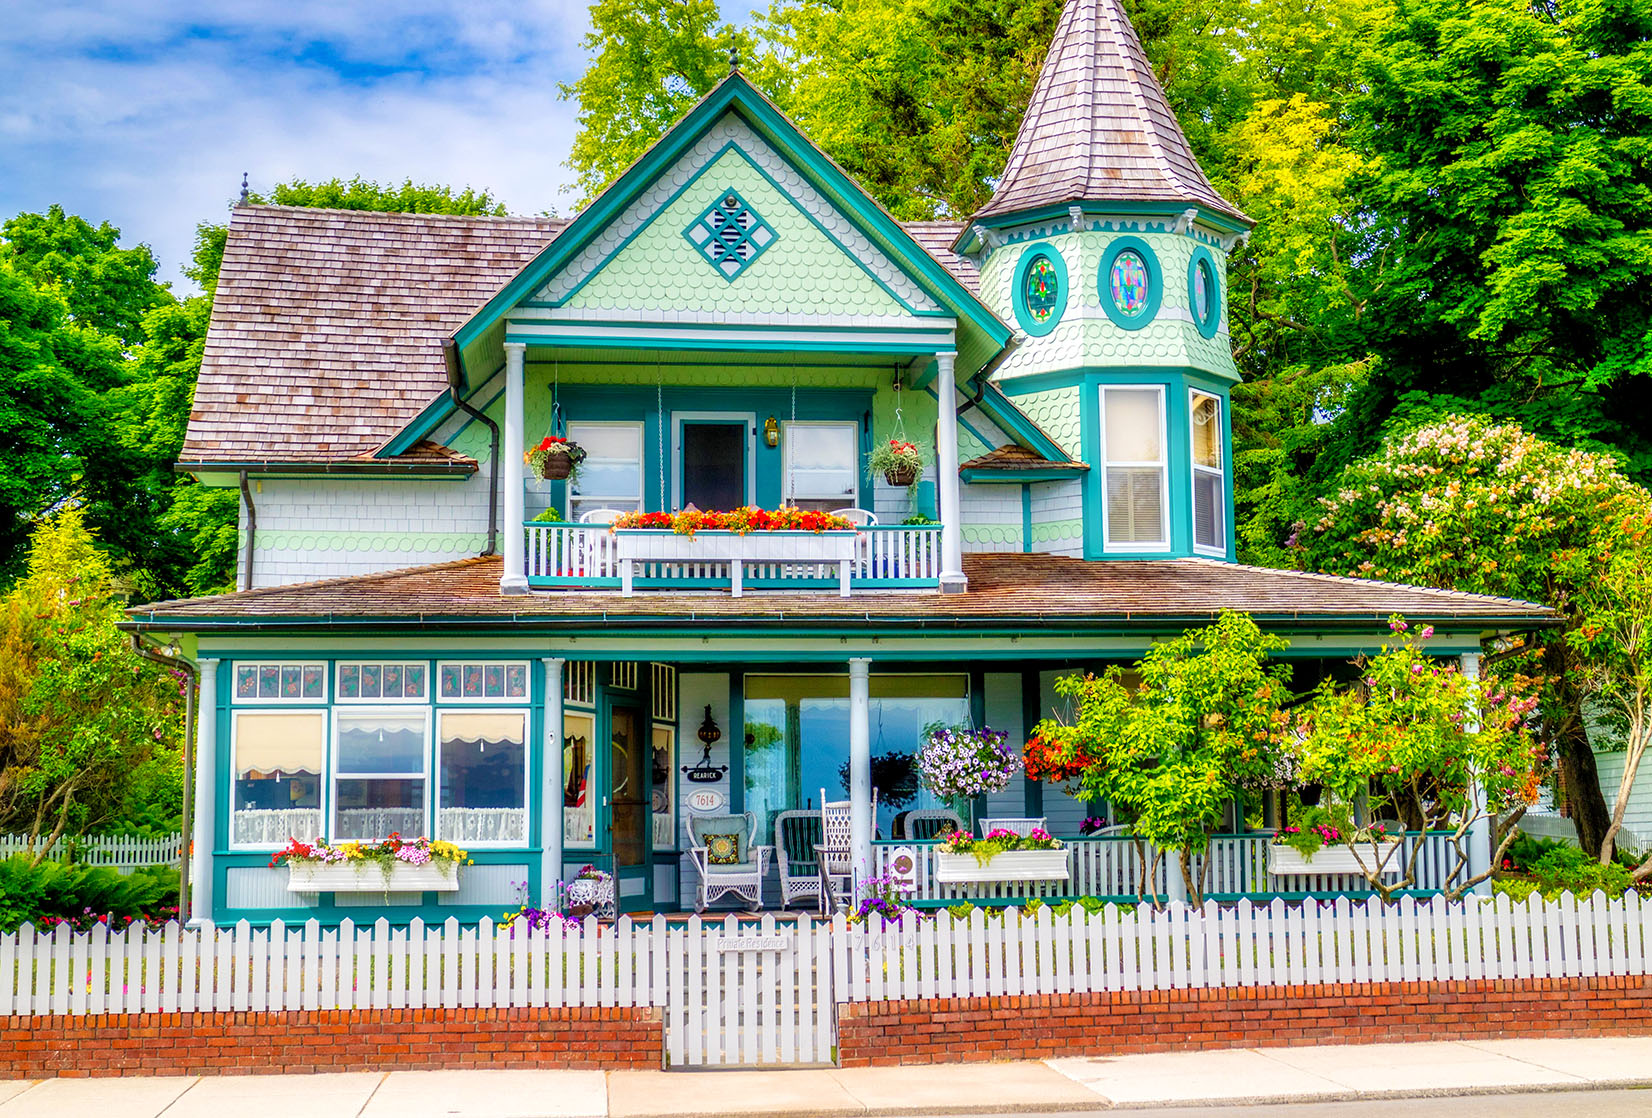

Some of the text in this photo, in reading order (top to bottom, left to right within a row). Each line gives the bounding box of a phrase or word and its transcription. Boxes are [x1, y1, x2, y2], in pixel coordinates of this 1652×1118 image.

[696, 795, 714, 806] 7614
[717, 937, 785, 949] Private Residence
